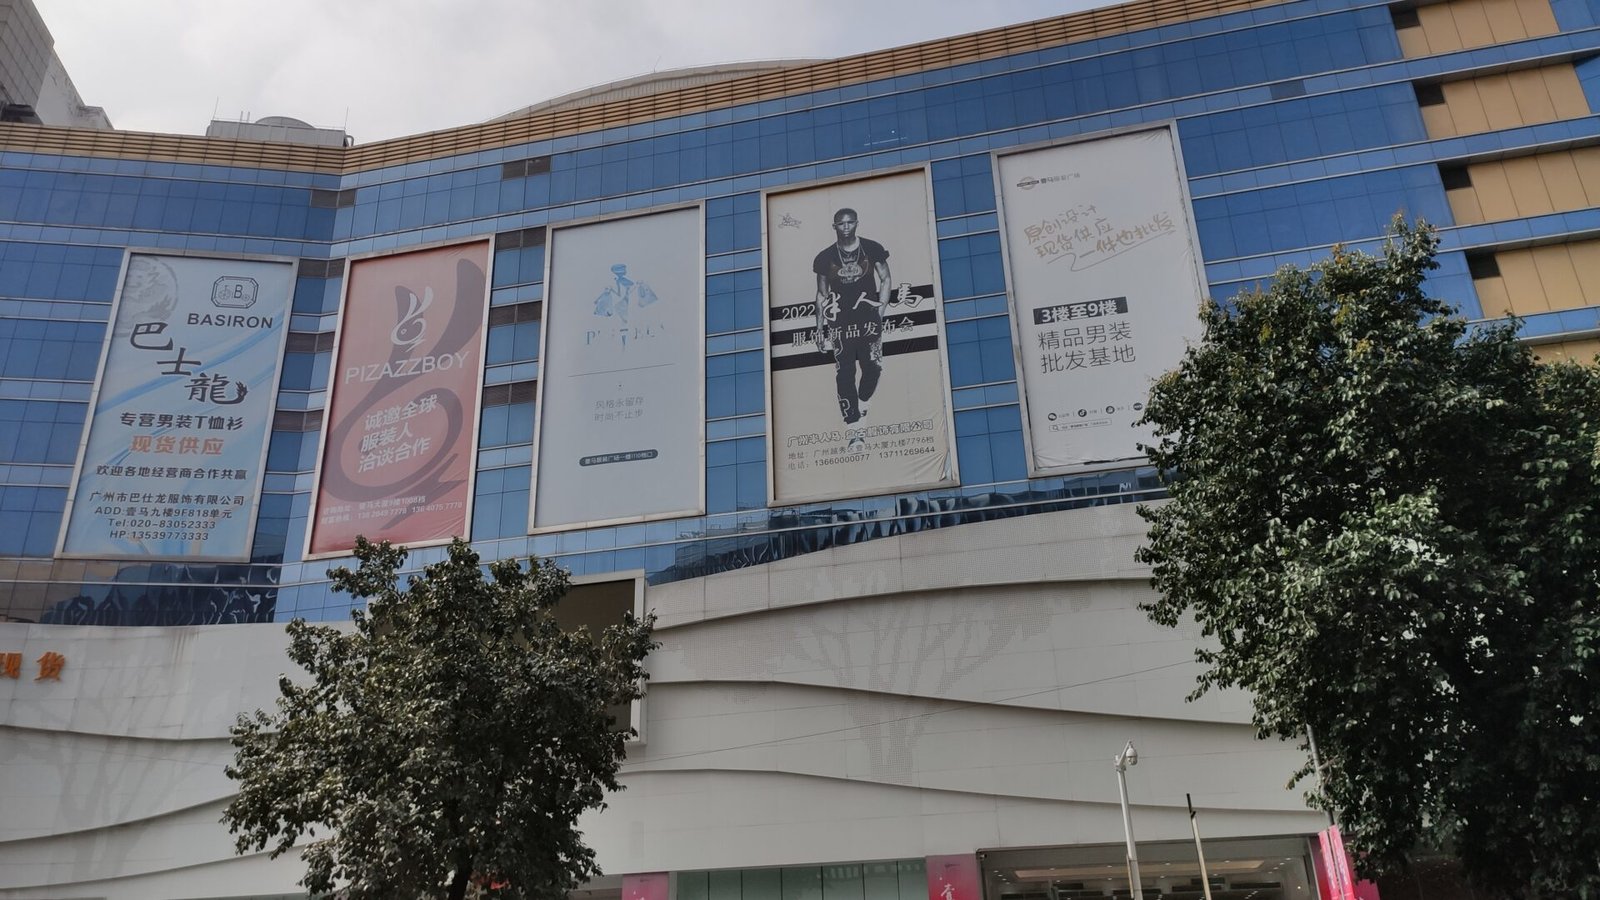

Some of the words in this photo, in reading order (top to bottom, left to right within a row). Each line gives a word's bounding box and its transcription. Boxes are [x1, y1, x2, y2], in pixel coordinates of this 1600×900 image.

[233, 284, 244, 299] B
[187, 313, 273, 329] BASIRON
[782, 304, 816, 321] 2022
[1041, 300, 1118, 323] 3楼至9楼
[791, 316, 915, 348] 服饰新品发布会
[1037, 321, 1132, 351] 精品男装
[345, 351, 470, 384] PIZAZZBOY
[1040, 344, 1137, 374] 批发基地
[119, 412, 243, 431] 专营男装T恤衫
[364, 393, 439, 431] 诚邀全球
[128, 435, 225, 456] 现货供应
[360, 422, 413, 452] 服装人
[358, 437, 432, 473] 洽谈合作
[95, 464, 248, 481] 欢迎各地经营商合作共赢
[88, 491, 246, 506] 广州市巴仕龙服饰有限公司
[109, 530, 210, 541] HP:13539773333
